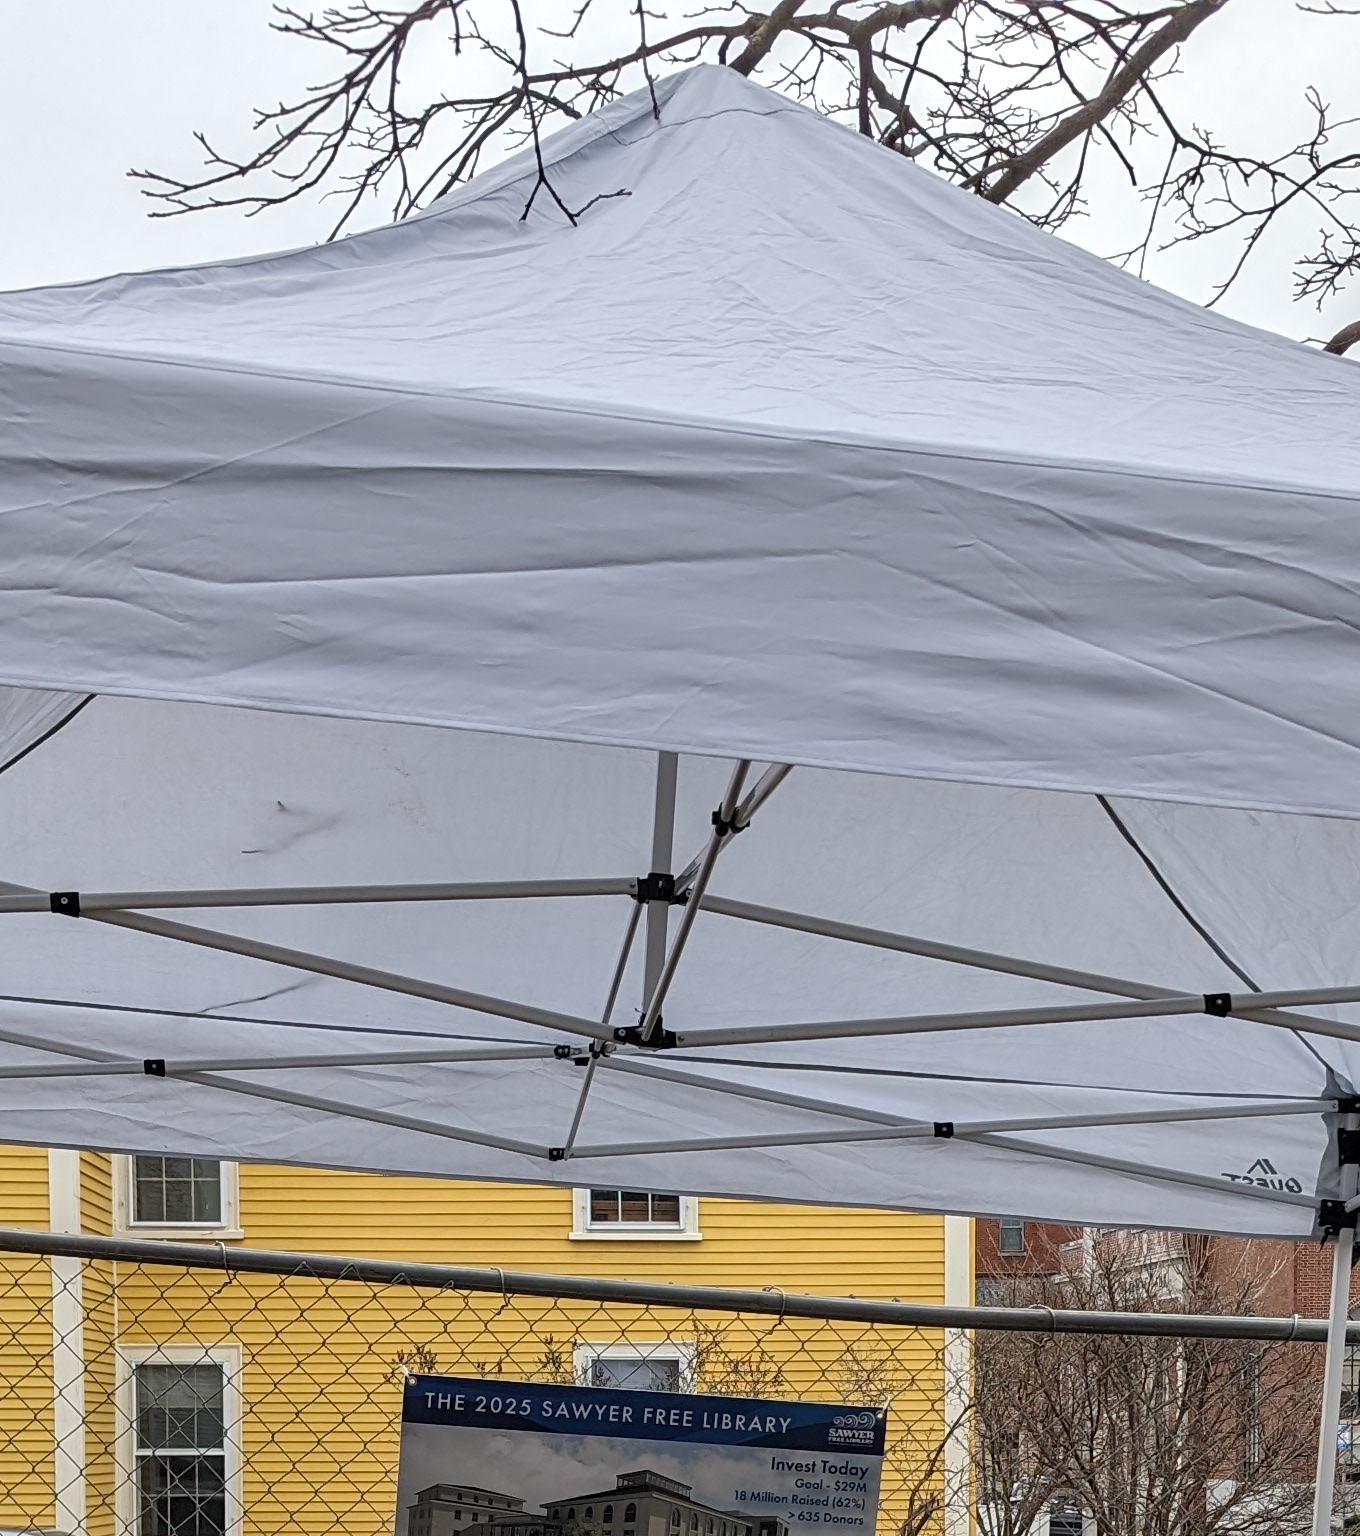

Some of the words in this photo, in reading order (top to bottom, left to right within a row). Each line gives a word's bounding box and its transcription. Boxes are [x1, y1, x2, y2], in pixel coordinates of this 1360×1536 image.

[424, 1392, 465, 1410] THE
[474, 1396, 531, 1414] 2025
[541, 1400, 633, 1422] SAWYER
[643, 1408, 693, 1426] FREE
[702, 1412, 791, 1433] LIBRARY
[828, 1428, 875, 1440] SAWYER
[770, 1456, 816, 1473] Invest
[820, 1459, 869, 1480] Today
[794, 1477, 823, 1489] Goal
[834, 1480, 867, 1493] $29M
[734, 1490, 746, 1500] 18
[749, 1490, 788, 1503] Million
[791, 1493, 828, 1506] Raised
[832, 1496, 865, 1510] (62%)
[797, 1511, 819, 1522] 635
[823, 1513, 863, 1525] Donors
